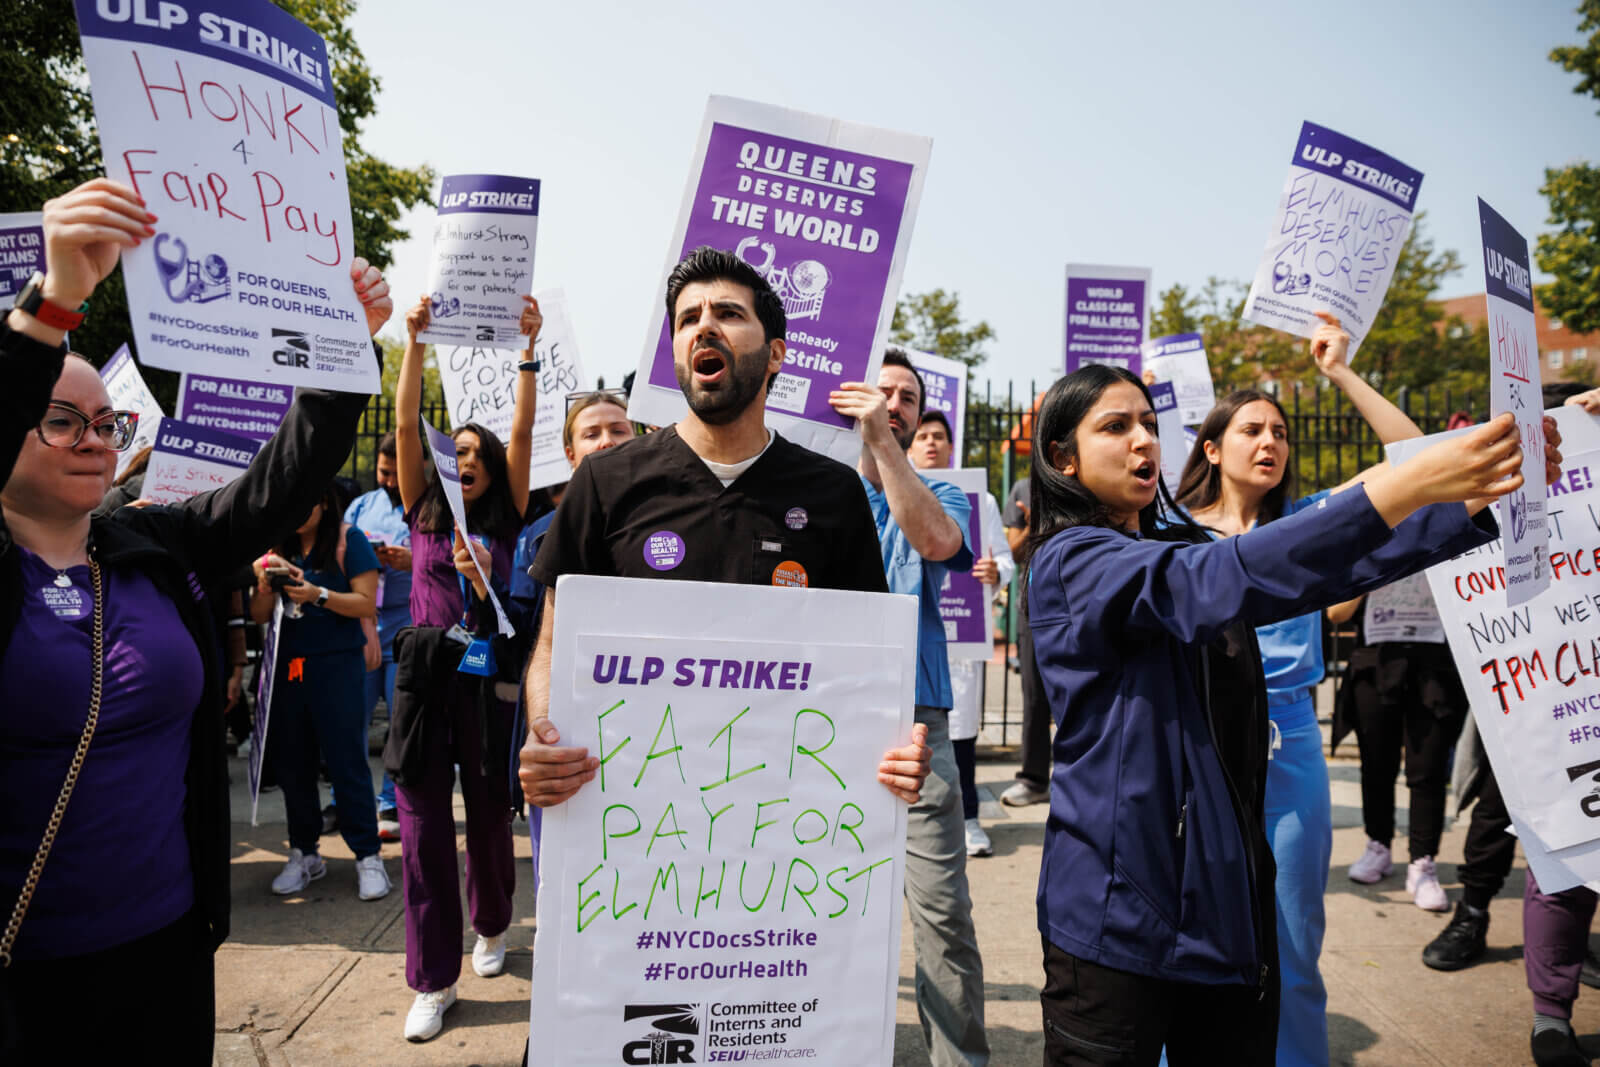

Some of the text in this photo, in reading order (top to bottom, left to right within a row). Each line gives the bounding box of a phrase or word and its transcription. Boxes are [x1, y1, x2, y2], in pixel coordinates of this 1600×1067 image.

[96, 0, 325, 85] ULP STRIKE!
[232, 139, 253, 164] 4
[737, 141, 877, 194] QUEENS
[1302, 144, 1414, 202] ULP STRIKE!
[443, 191, 533, 210] ULP STRIKE!
[737, 175, 864, 216] DESERVES
[1286, 171, 1410, 242] ELMHURST
[711, 195, 880, 253] THE WORLD
[18, 233, 40, 248] CIR
[1281, 211, 1390, 271] DESERVES
[1486, 247, 1504, 280] ULP
[238, 272, 268, 288] FOR
[1087, 287, 1124, 299] WORLD
[1315, 283, 1332, 293] FOR
[239, 292, 358, 323] FOR OUR HEALTH.
[1076, 301, 1136, 313] CLASS CARE
[1311, 292, 1329, 303] FOR
[149, 312, 259, 339] #NYCDocsStrike
[1069, 314, 1089, 325] FOR
[151, 334, 250, 358] #ForOurHealth
[315, 334, 368, 349] Committee of
[345, 350, 360, 358] and
[535, 338, 564, 367] HE
[315, 353, 354, 365] Residents
[191, 380, 218, 393] FOR
[219, 383, 246, 399] ALL
[247, 387, 266, 399] OF
[457, 365, 578, 424] CARETERS
[161, 434, 254, 465] ULP STRIKE!
[1455, 567, 1506, 601] COVI
[593, 654, 812, 691] ULP STRIKE!
[1481, 649, 1548, 715] 7PM
[597, 699, 847, 793] FAIR
[602, 797, 865, 861] PAY FOR
[577, 857, 893, 933] ELMHURST
[637, 929, 818, 950] #NYCDocsStrike
[644, 960, 808, 981] #ForOurHealth
[711, 998, 819, 1017] Committee of
[710, 1015, 801, 1032] Interns and
[622, 1039, 696, 1066] CIR
[708, 1032, 787, 1047] Residents
